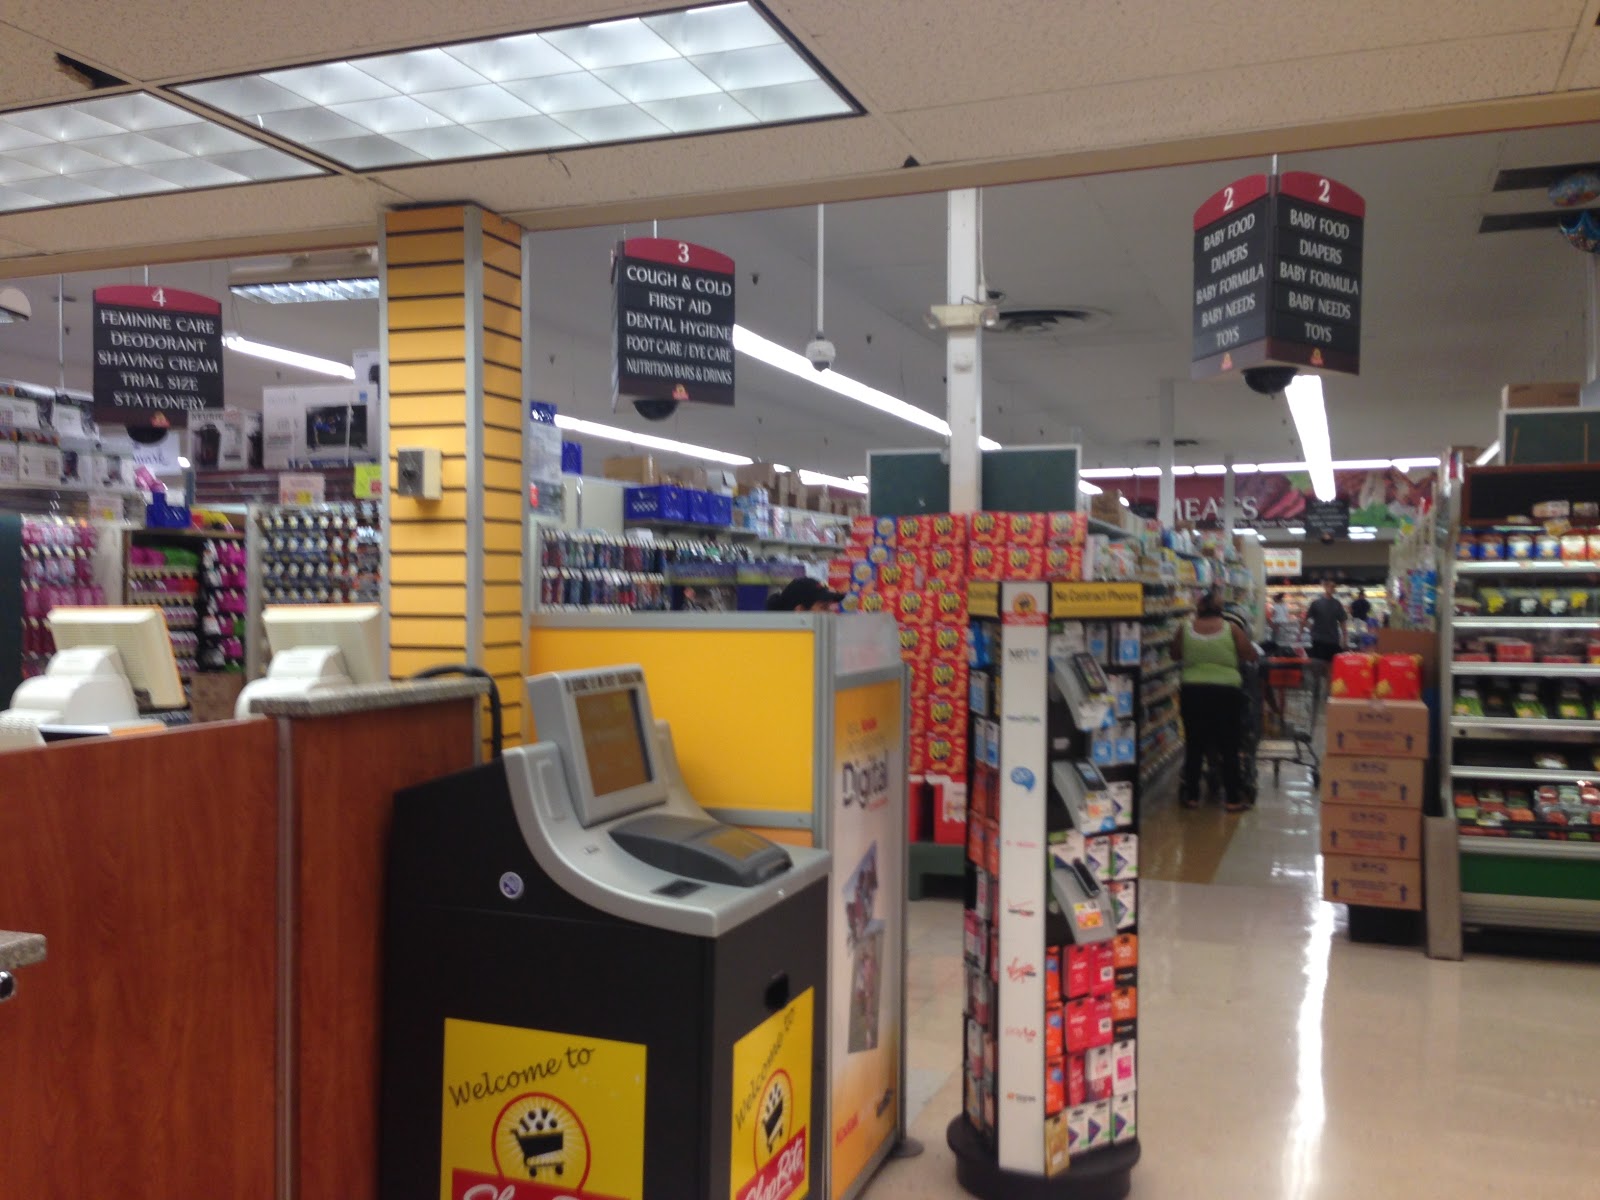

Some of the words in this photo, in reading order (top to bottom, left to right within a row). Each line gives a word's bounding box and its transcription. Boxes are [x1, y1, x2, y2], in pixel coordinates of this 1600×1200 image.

[1223, 187, 1234, 211] 2
[1318, 178, 1330, 203] 2
[1203, 228, 1226, 252] BABY
[1227, 213, 1255, 240] FOOD
[1290, 209, 1316, 230] BABY
[1319, 217, 1350, 240] FOOD
[678, 242, 690, 263] 3
[1211, 243, 1249, 274] DIAPERS
[1300, 239, 1342, 265] DIAPERS
[627, 265, 677, 288] COUGH
[682, 275, 691, 290] &
[696, 278, 732, 297] COLD
[1196, 283, 1216, 305] BABY
[1219, 263, 1264, 295] FORMULA
[1280, 262, 1307, 282] BABY
[1310, 269, 1358, 295] FORMULA
[152, 286, 167, 307] 4
[649, 292, 685, 311] FIRST
[688, 299, 712, 316] AID
[1289, 291, 1315, 311] BABY
[1318, 298, 1351, 320] NEEDS
[101, 309, 172, 331] FEMININE
[176, 316, 215, 334] CARE
[1202, 306, 1222, 328] BABY
[1225, 293, 1256, 319] NEEDS
[627, 311, 676, 334] DENTAL
[680, 319, 732, 341] HYGIENE
[1216, 326, 1240, 348] TOYS
[1304, 322, 1332, 343] TOYS
[111, 330, 206, 352] DEODORANT
[627, 334, 656, 352] FOOT
[656, 338, 682, 357] CARE
[688, 343, 706, 360] EYE
[707, 346, 732, 363] CARE
[98, 350, 164, 370] SHAVING
[168, 355, 219, 374] CREAM
[627, 358, 673, 378] NUTRITION
[674, 362, 695, 381] BARS
[703, 366, 732, 385] DRINKS
[120, 371, 164, 389] TRIAL
[167, 374, 199, 391] SIZE
[113, 391, 206, 411] STATIONERY
[1176, 497, 1258, 520] EAS
[449, 1057, 563, 1107] Welcome
[564, 1046, 595, 1069] to
